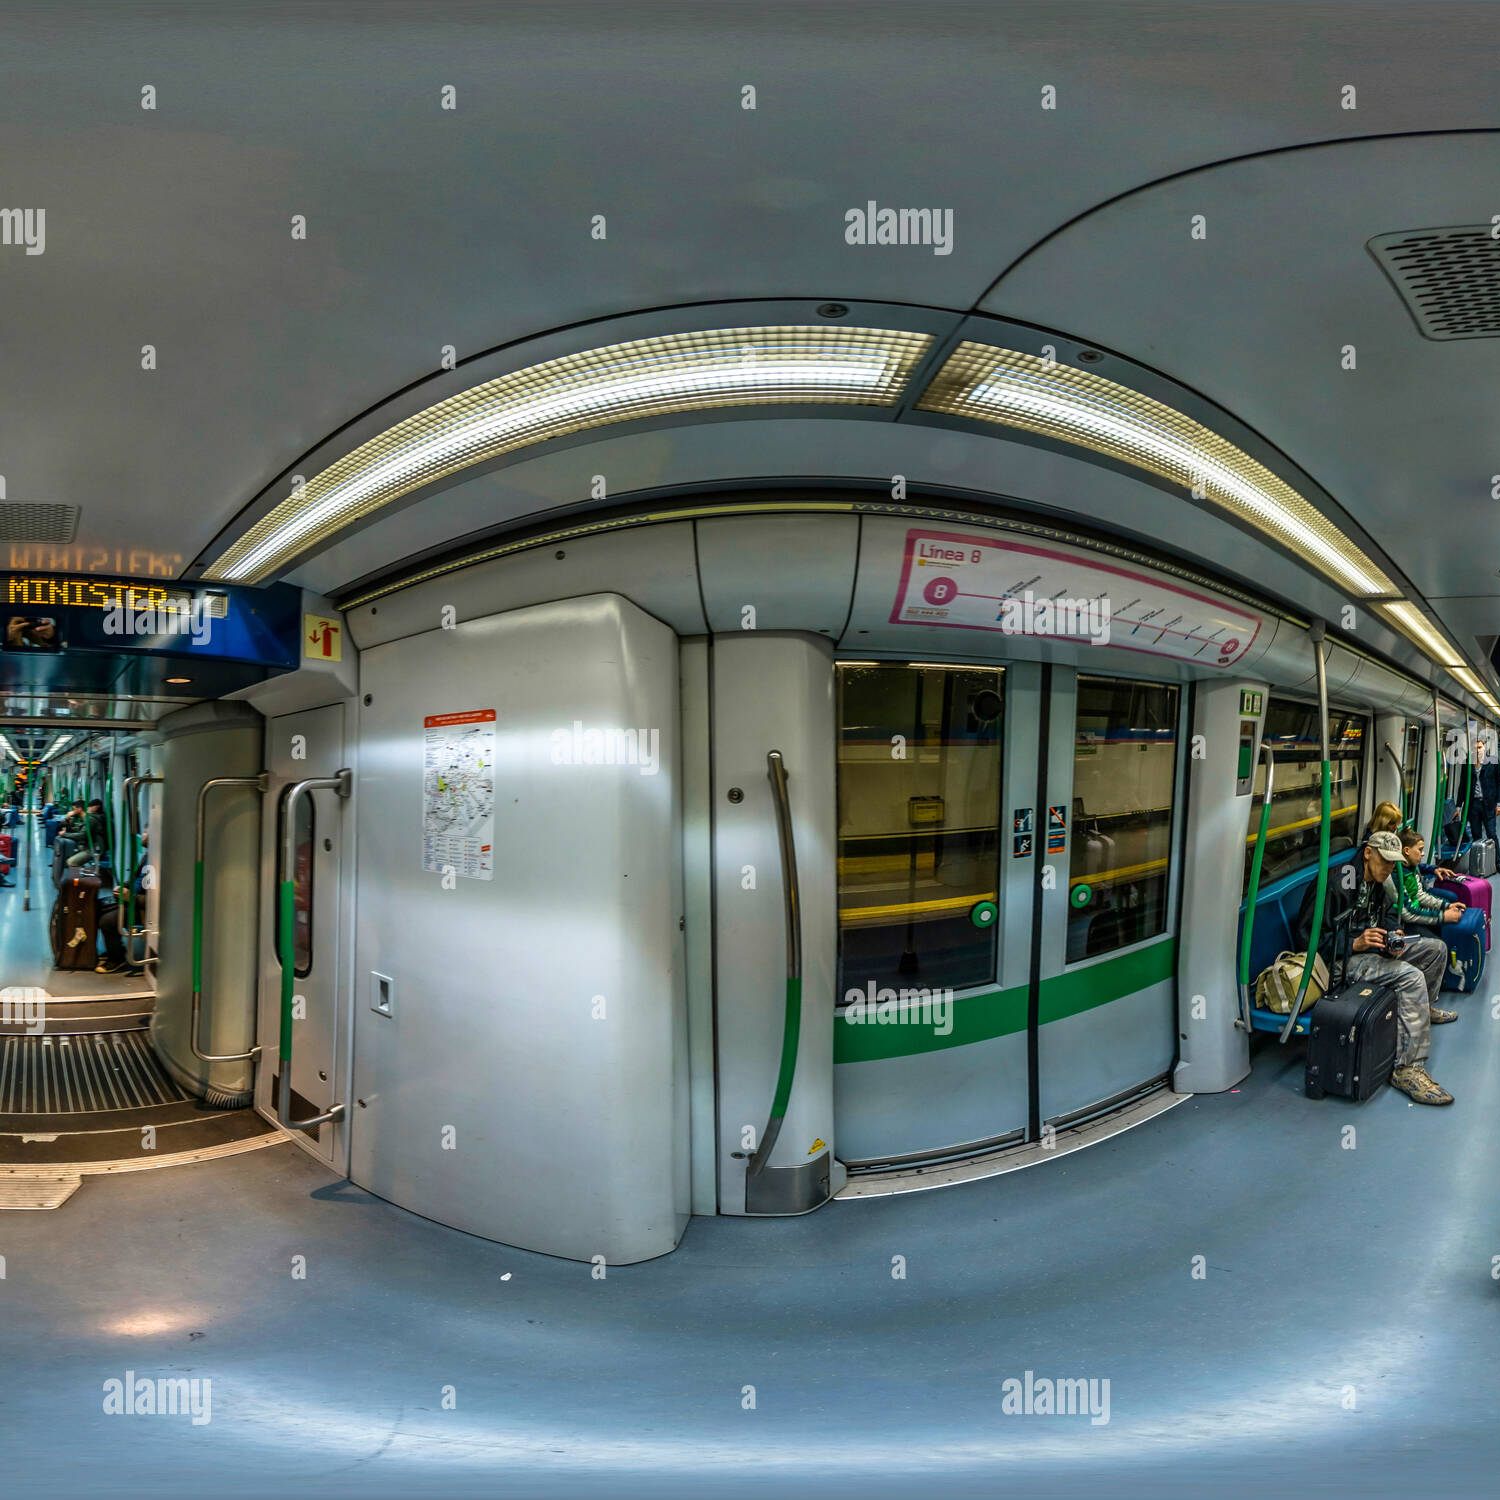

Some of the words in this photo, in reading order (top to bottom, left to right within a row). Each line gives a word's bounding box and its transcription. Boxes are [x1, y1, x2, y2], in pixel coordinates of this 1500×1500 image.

[919, 543, 965, 562] Línea
[970, 549, 982, 564] 8
[934, 584, 948, 599] 8
